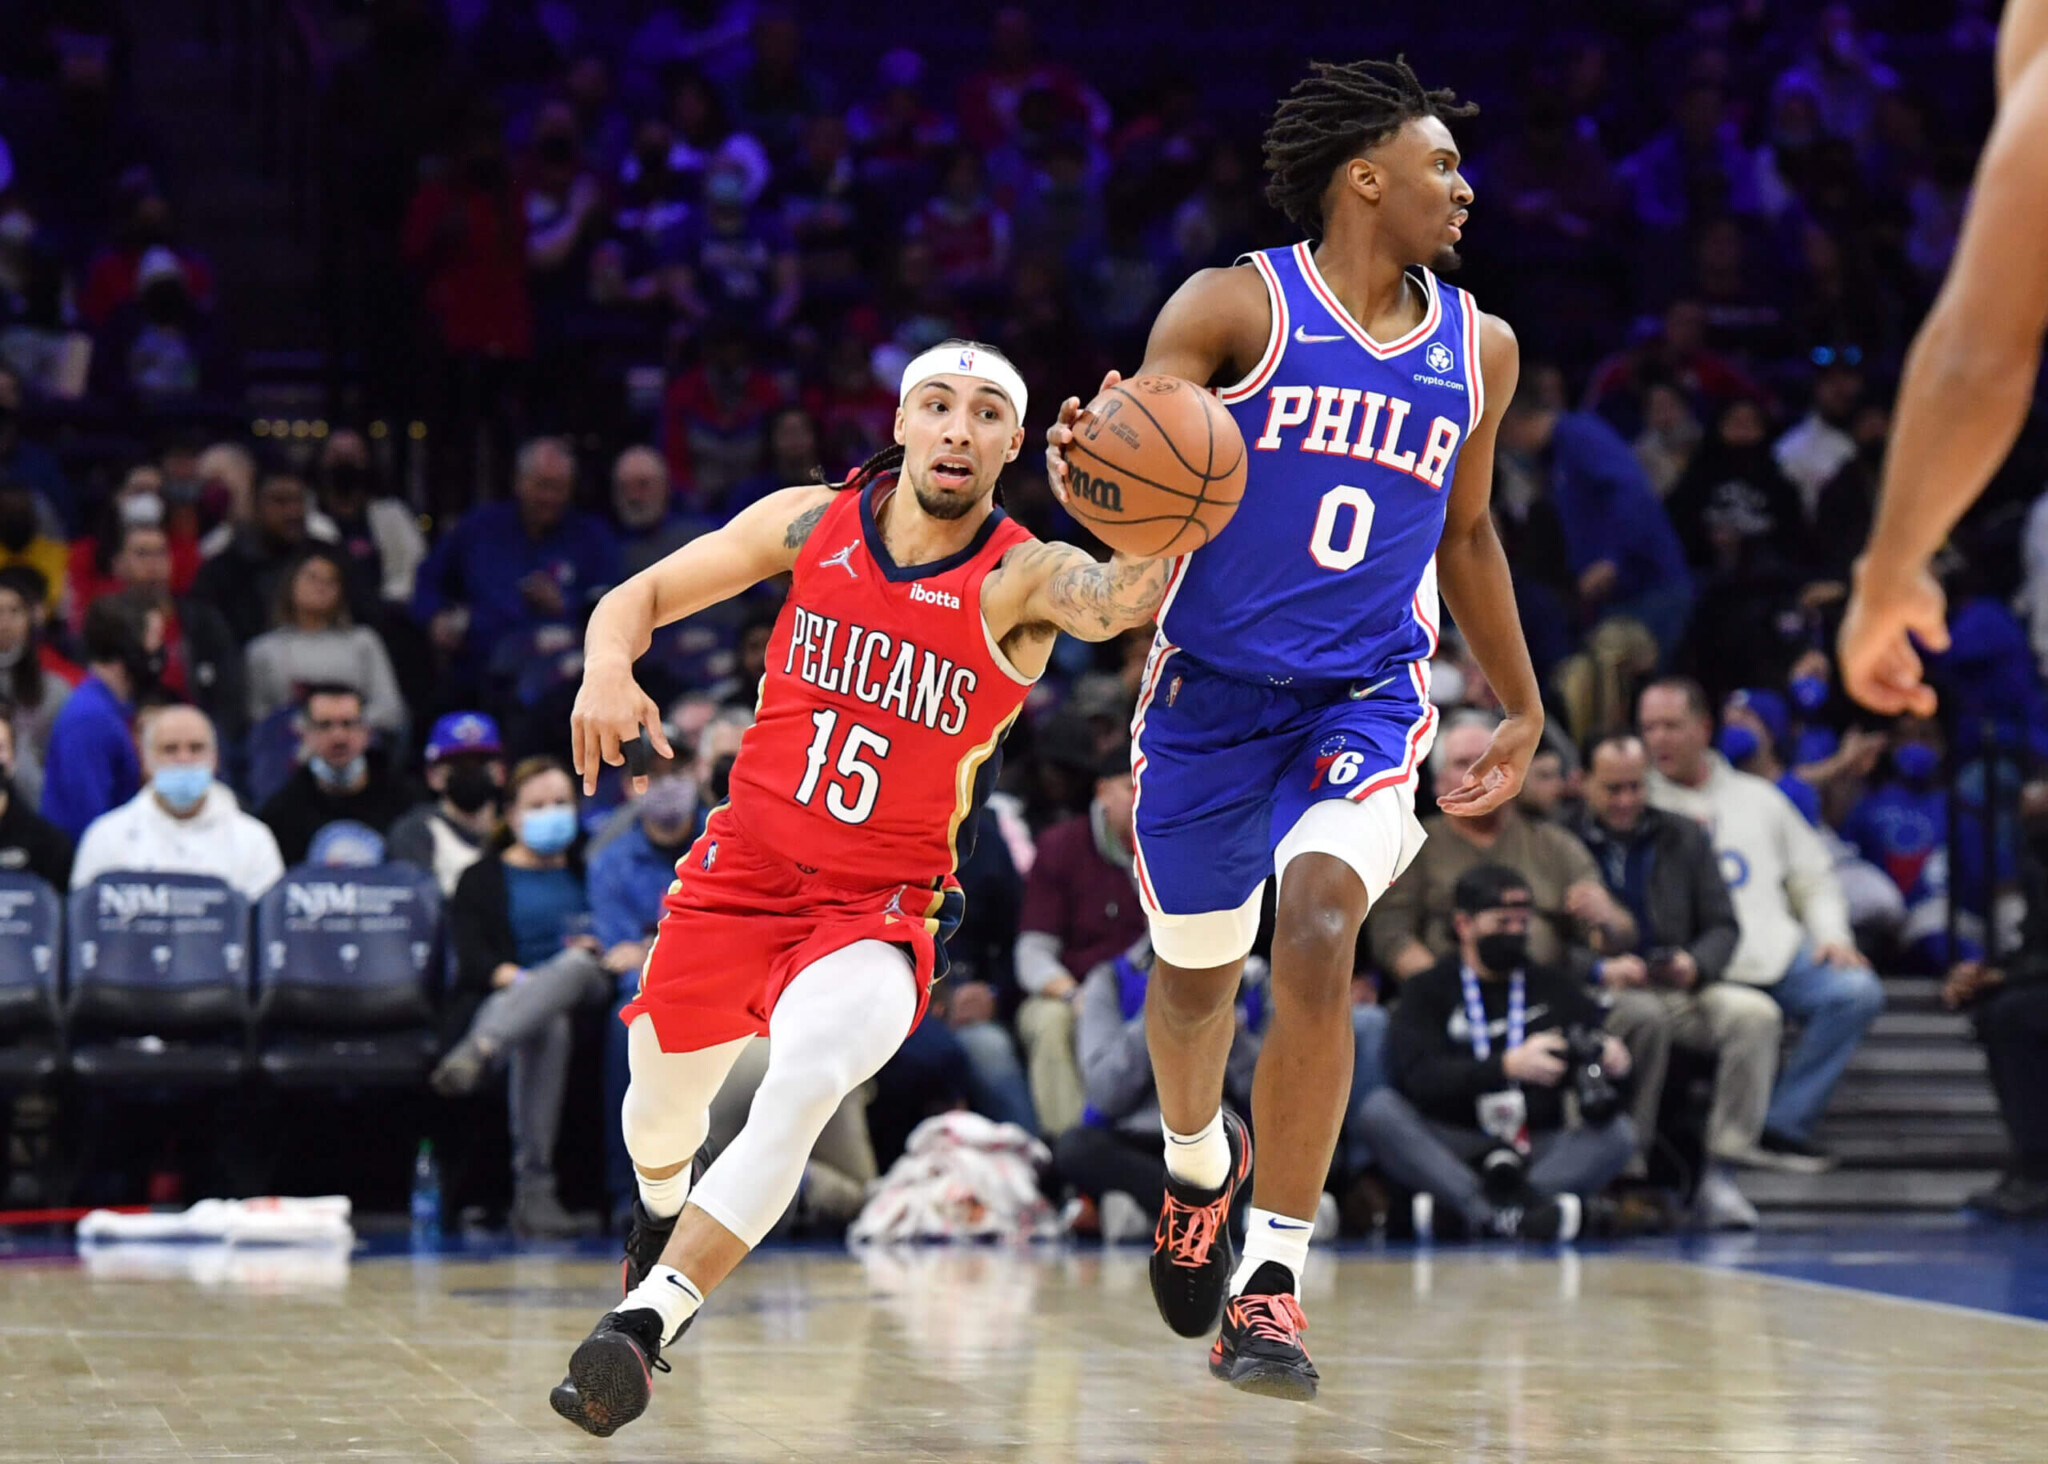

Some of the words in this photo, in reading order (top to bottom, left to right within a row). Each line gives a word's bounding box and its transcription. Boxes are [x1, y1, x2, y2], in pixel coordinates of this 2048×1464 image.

[1413, 372, 1465, 392] crypto.com
[1255, 385, 1461, 490] PHILA
[1308, 484, 1376, 572] 0
[909, 582, 960, 609] ibotta
[784, 604, 978, 736] PELICANS
[794, 707, 892, 825] 15
[1309, 750, 1365, 792] 76
